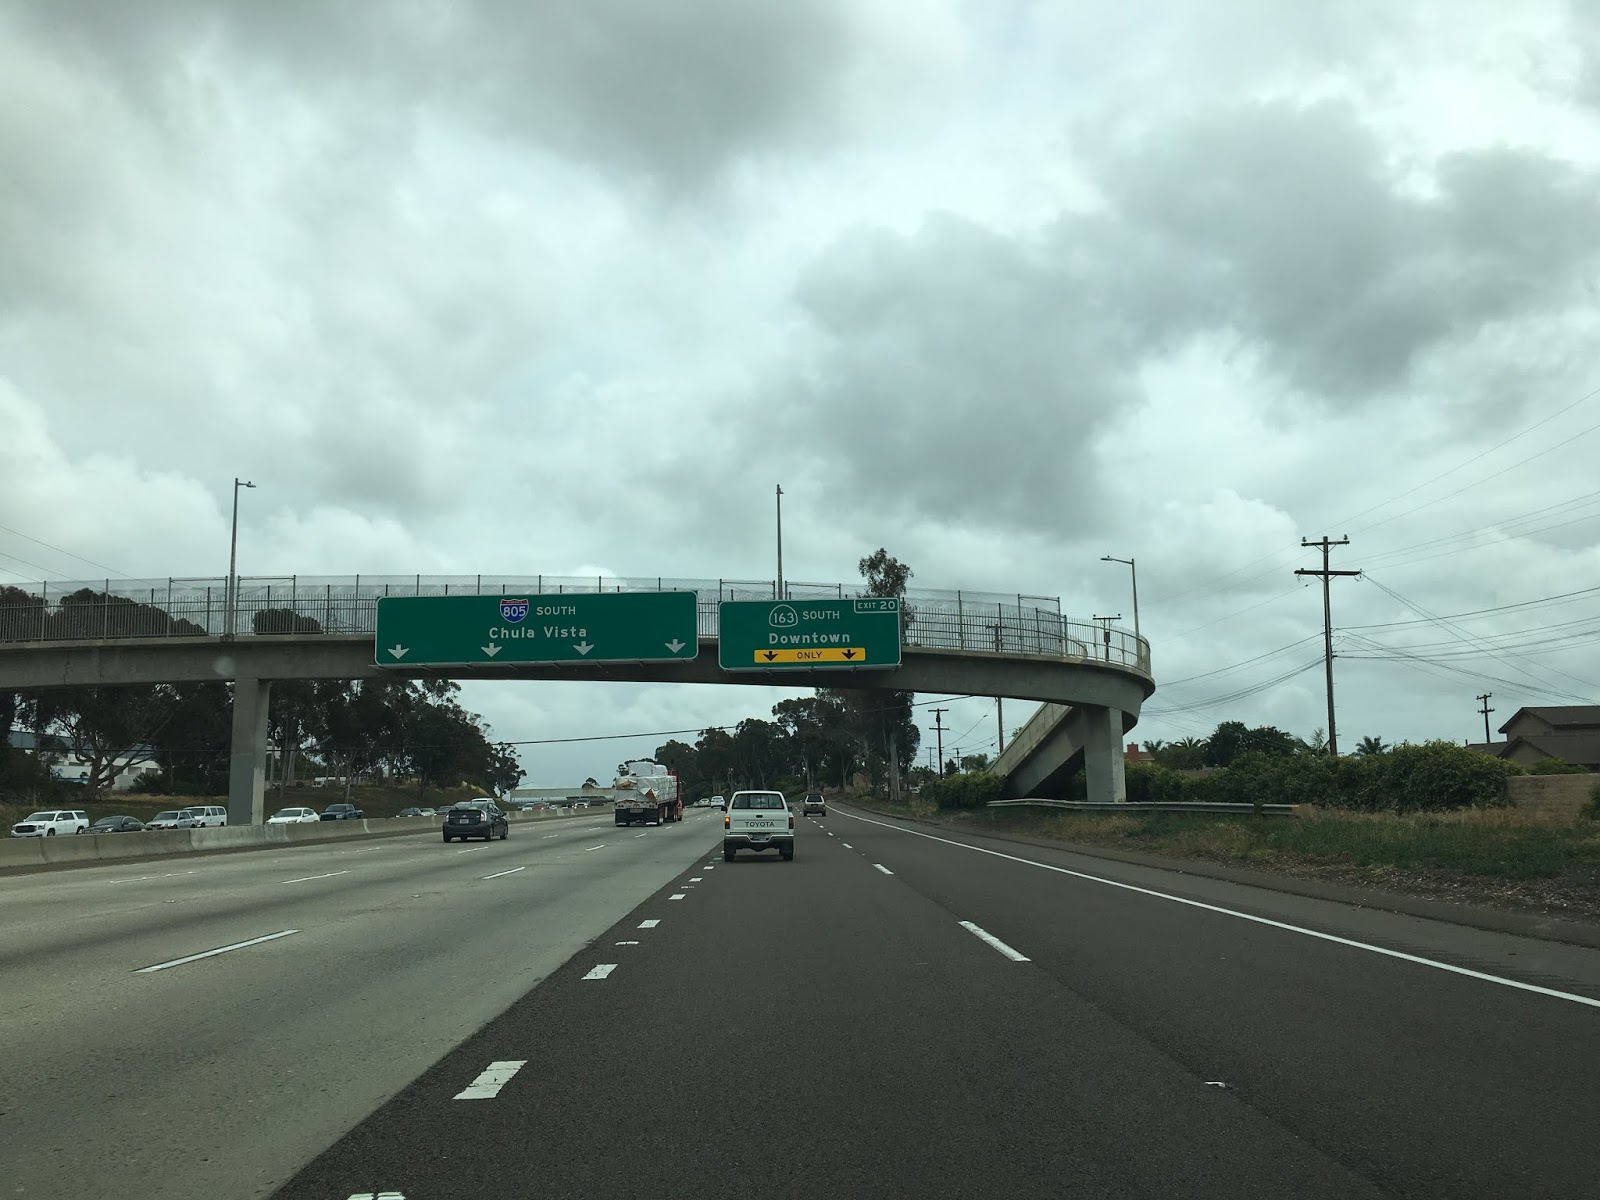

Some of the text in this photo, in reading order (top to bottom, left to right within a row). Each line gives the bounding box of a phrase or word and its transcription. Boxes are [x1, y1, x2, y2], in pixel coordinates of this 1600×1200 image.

[879, 601, 896, 610] 20
[503, 606, 576, 617] 805 SOUTH
[773, 610, 840, 624] 163 SOUTH
[489, 626, 587, 639] Chula Vista
[769, 632, 850, 644] Downtown
[797, 651, 822, 659] ONLY
